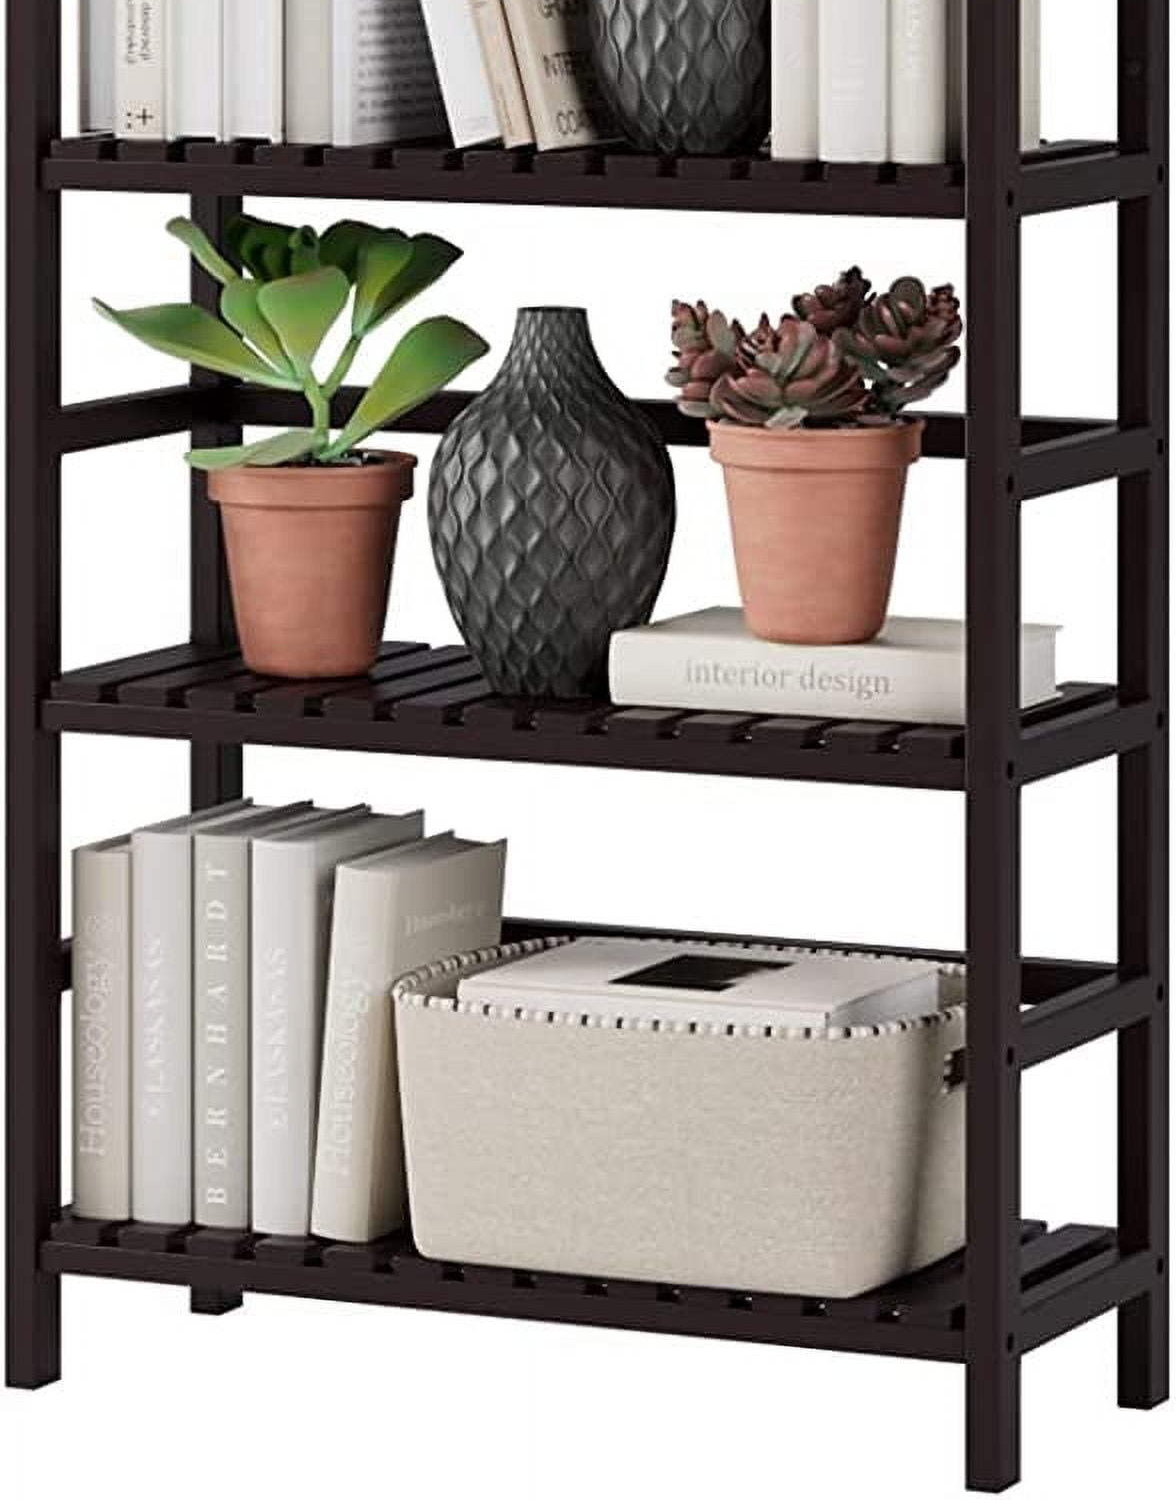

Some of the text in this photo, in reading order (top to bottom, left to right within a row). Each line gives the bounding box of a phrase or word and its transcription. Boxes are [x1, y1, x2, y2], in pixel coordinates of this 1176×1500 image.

[685, 657, 893, 700] interior design
[80, 960, 113, 1157] Houseology
[207, 861, 229, 1205] BERNHARDT
